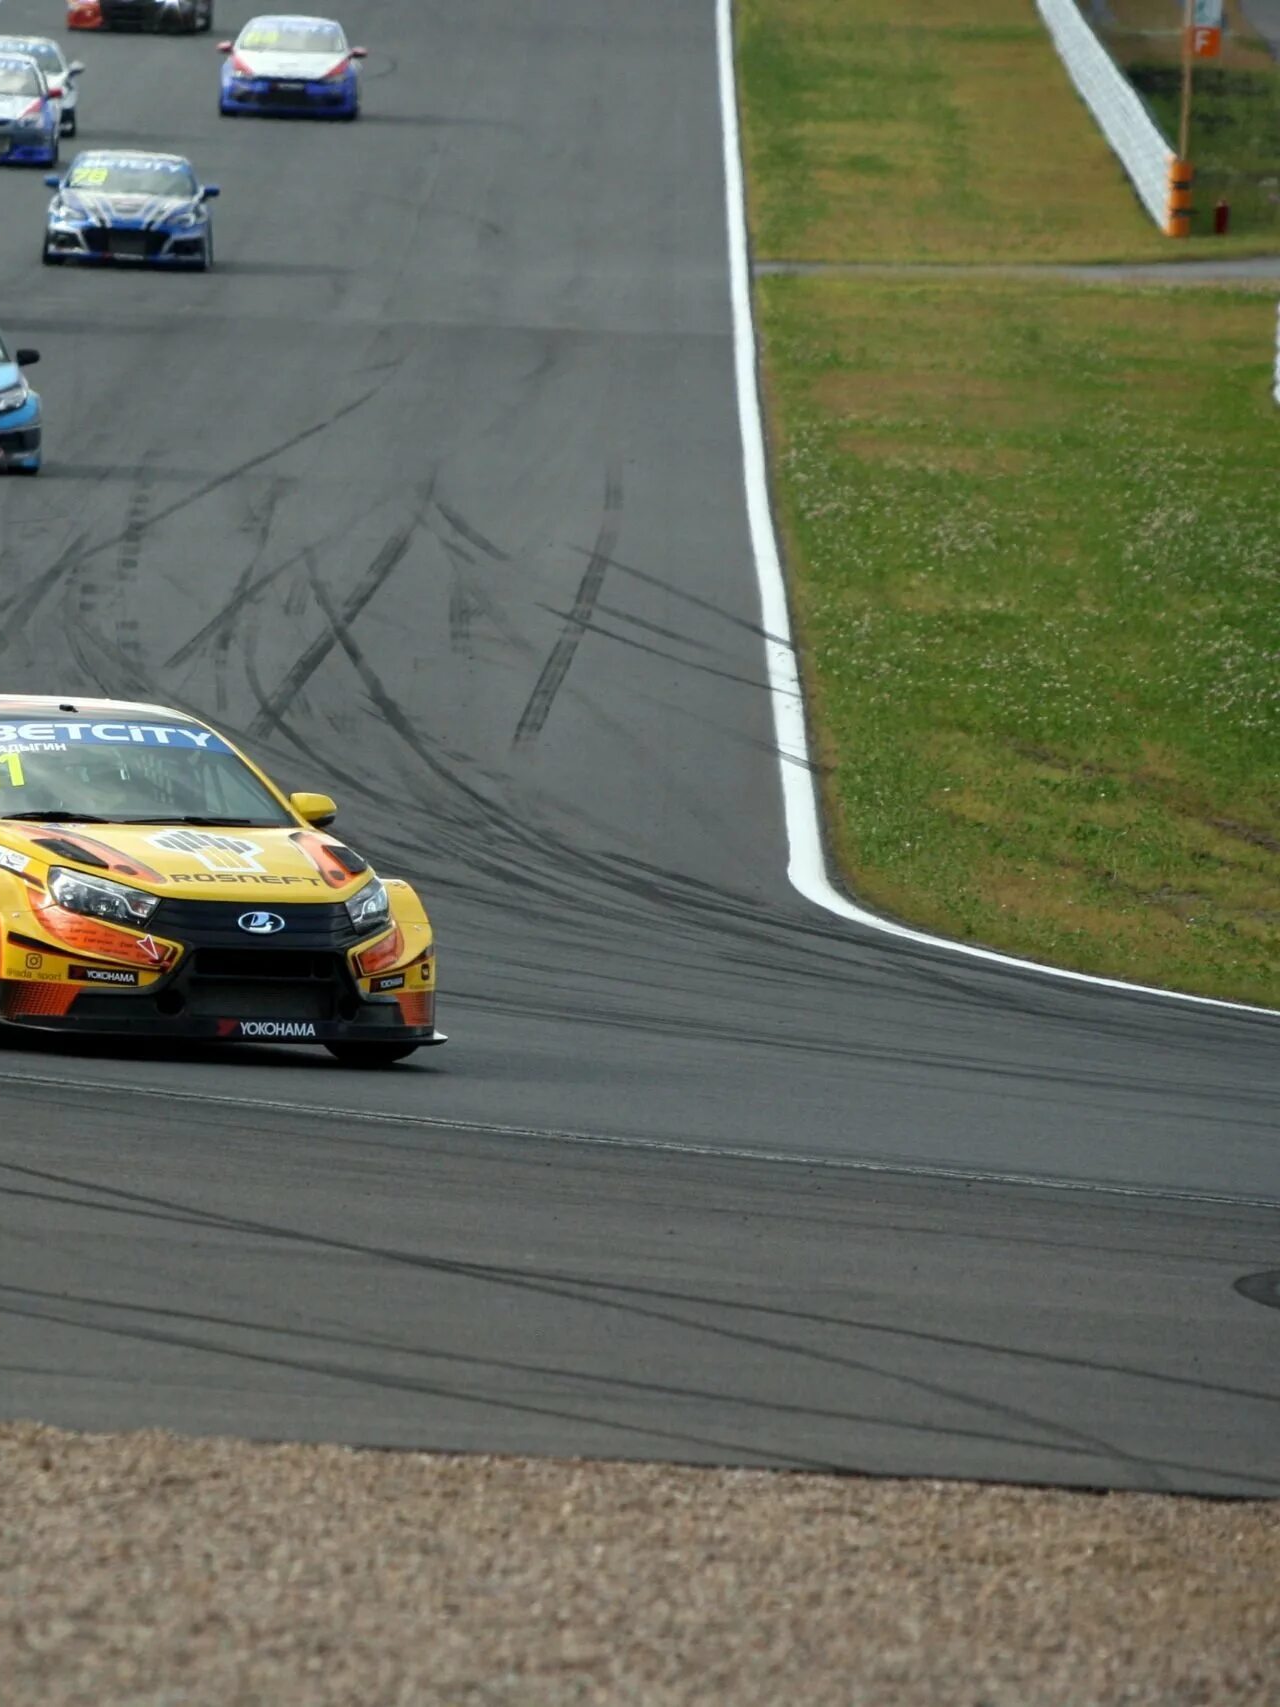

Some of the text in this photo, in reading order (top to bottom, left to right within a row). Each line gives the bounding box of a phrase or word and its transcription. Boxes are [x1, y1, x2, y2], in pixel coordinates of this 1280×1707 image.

[1195, 29, 1211, 51] F
[170, 873, 322, 887] ROSNEFT
[86, 969, 136, 983] YOKOHAMA
[240, 1021, 317, 1037] YOKOHAMA
